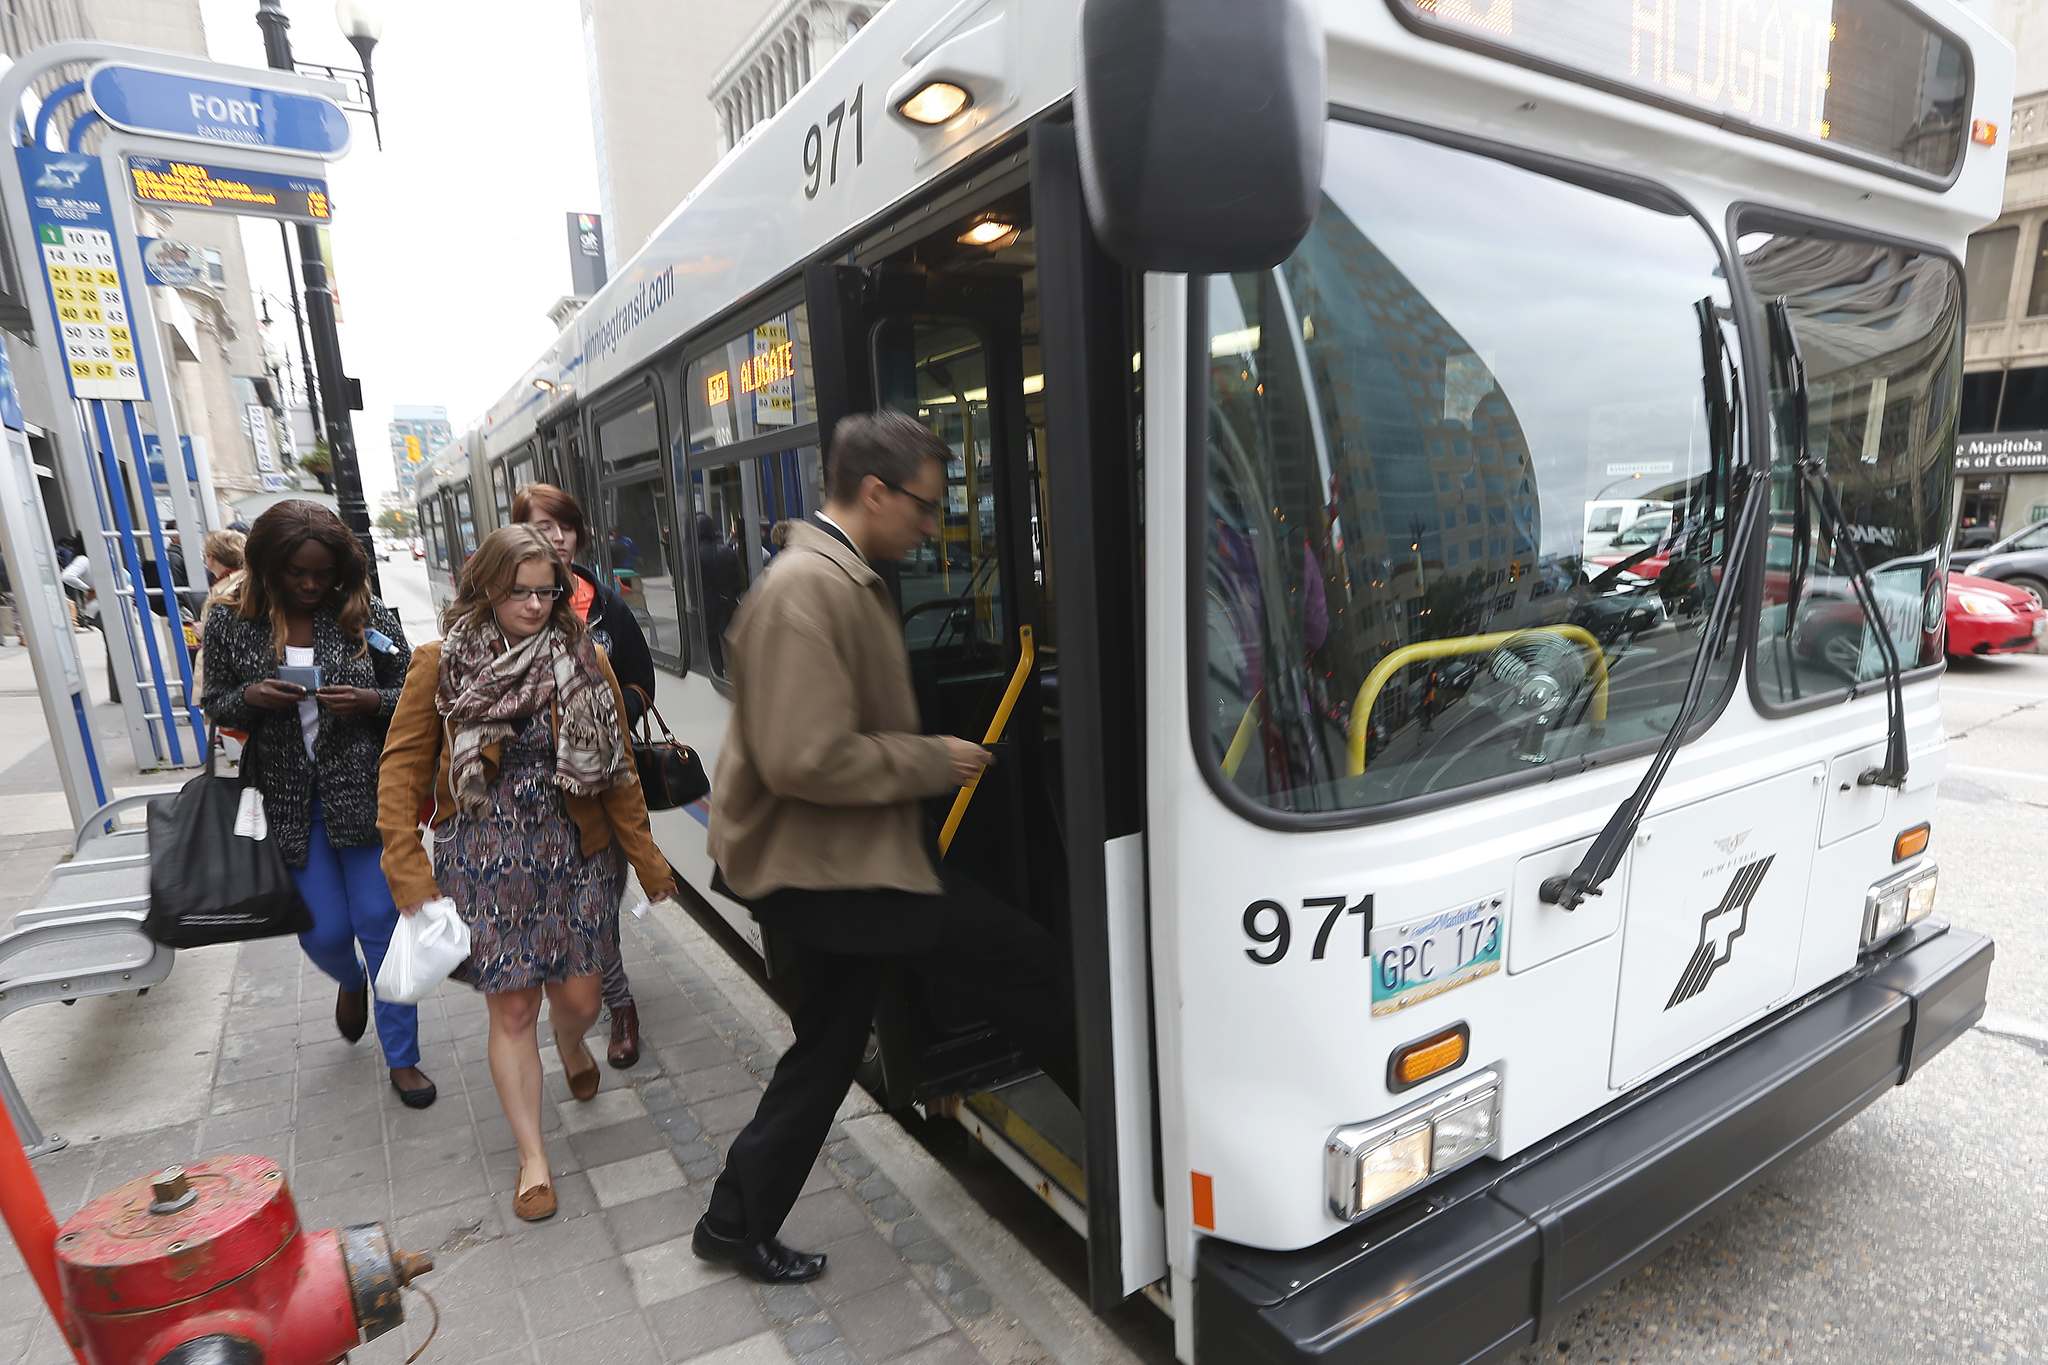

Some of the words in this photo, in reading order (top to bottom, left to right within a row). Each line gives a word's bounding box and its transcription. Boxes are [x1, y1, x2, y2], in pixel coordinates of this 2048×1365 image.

[188, 91, 263, 127] FORT
[802, 82, 863, 201] 971
[69, 232, 85, 244] 10
[92, 234, 107, 246] 11
[49, 248, 65, 260] 14
[73, 251, 89, 263] 15
[96, 254, 112, 265] 19
[54, 268, 69, 281] 21
[77, 270, 94, 283] 22
[98, 272, 117, 285] 24
[58, 288, 74, 300] 25
[80, 288, 97, 302] 28
[62, 307, 79, 320] 40
[84, 308, 100, 320] 41
[107, 309, 124, 322] 43
[65, 326, 82, 338] 50
[88, 327, 105, 339] 53
[111, 329, 128, 340] 54
[69, 345, 86, 357] 55
[92, 346, 110, 358] 56
[114, 347, 131, 359] 57
[73, 364, 91, 376] 59
[96, 365, 113, 377] 67
[119, 366, 136, 378] 68
[710, 375, 727, 403] 59
[740, 341, 794, 393] ALDGATE
[1969, 437, 2042, 455] Manitoba
[1974, 454, 1991, 467] of
[1995, 453, 2048, 467] Comm
[1242, 892, 1374, 965] 971
[1381, 938, 1436, 991] GPC
[1457, 916, 1498, 966] 173
